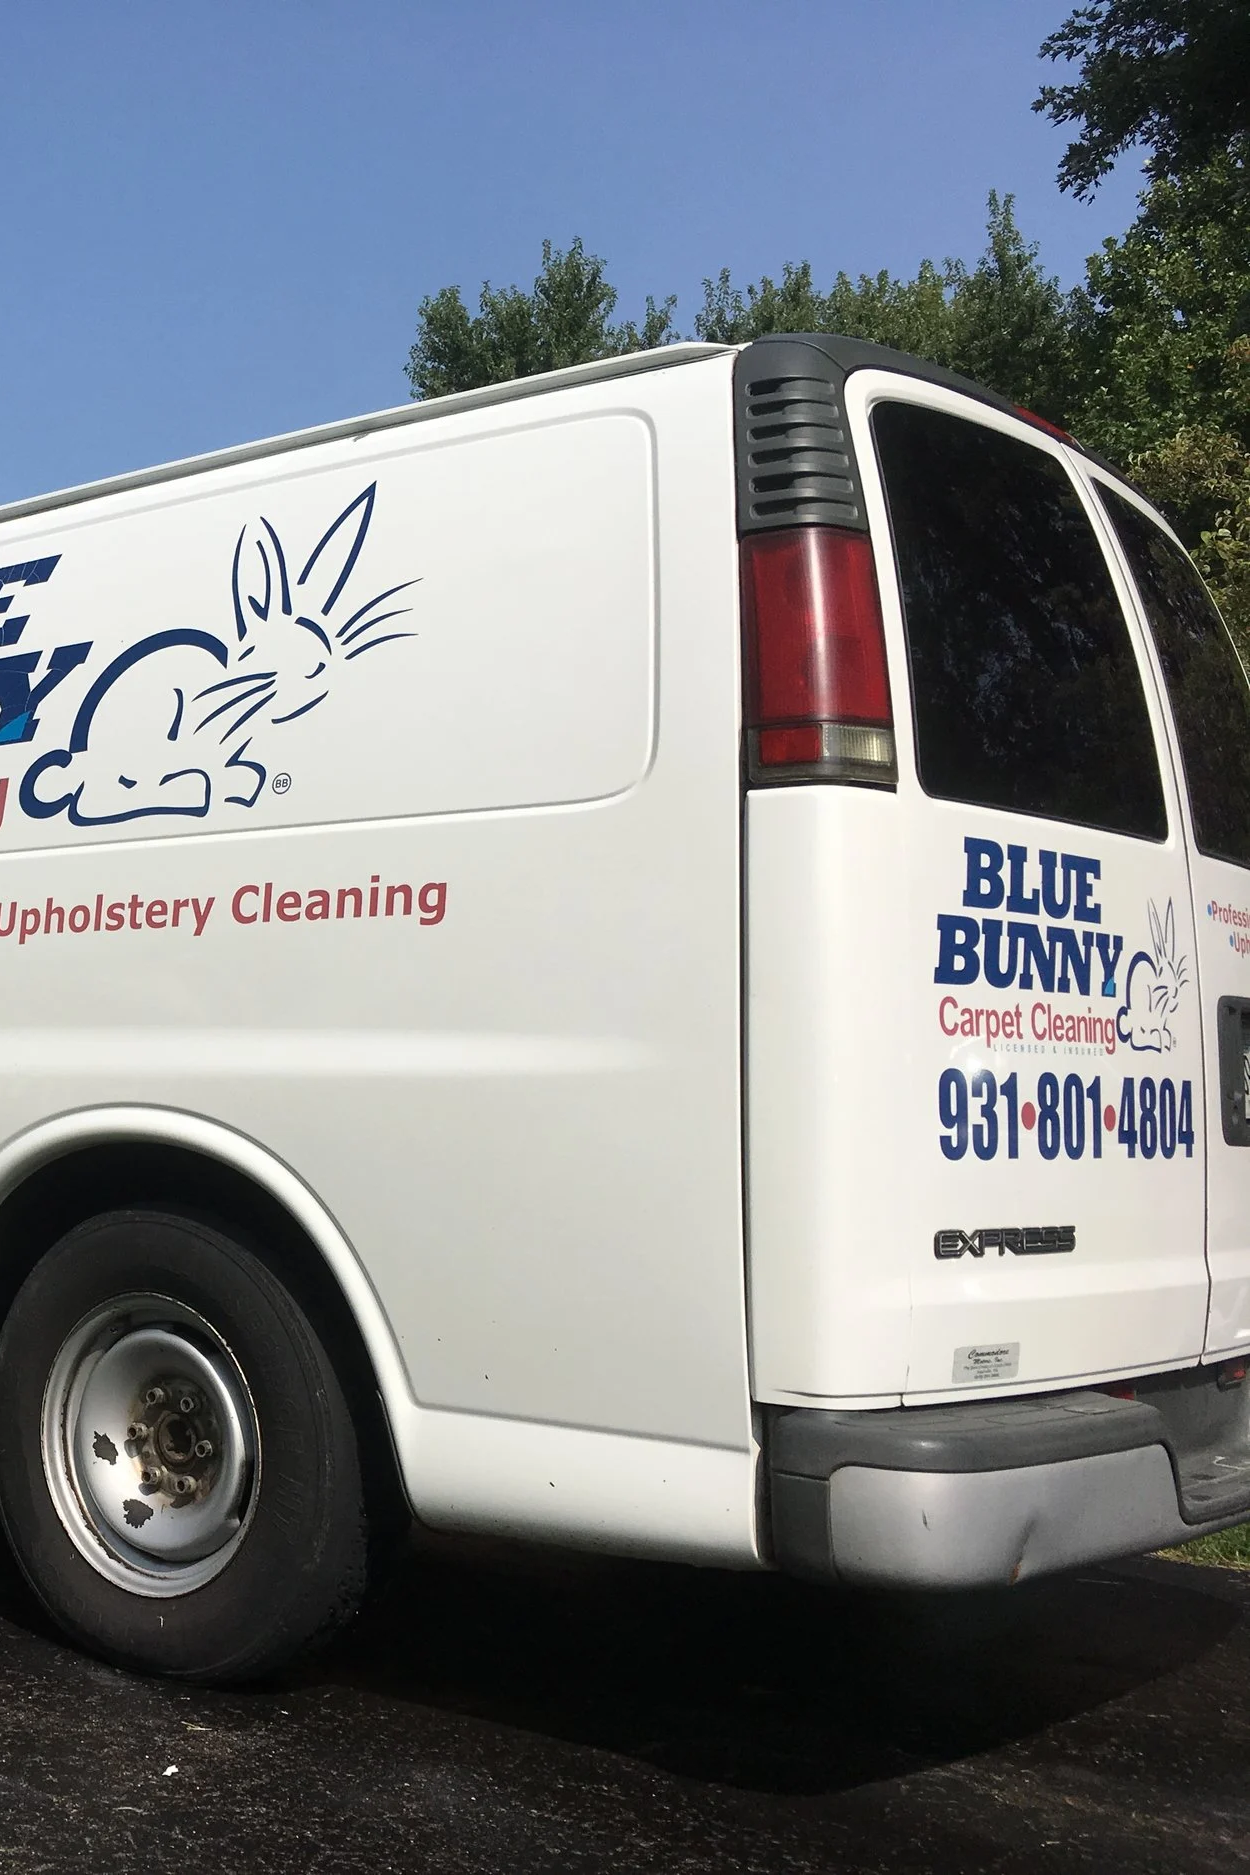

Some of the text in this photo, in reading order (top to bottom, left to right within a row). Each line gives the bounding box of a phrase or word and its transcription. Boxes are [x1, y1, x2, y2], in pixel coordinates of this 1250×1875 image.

[231, 874, 448, 926] Cleaning
[962, 836, 1102, 924] BLUE
[934, 914, 1124, 998] BUNNY
[939, 996, 1116, 1055] Carpet Cleaning
[934, 1226, 1076, 1260] EXPRESS
